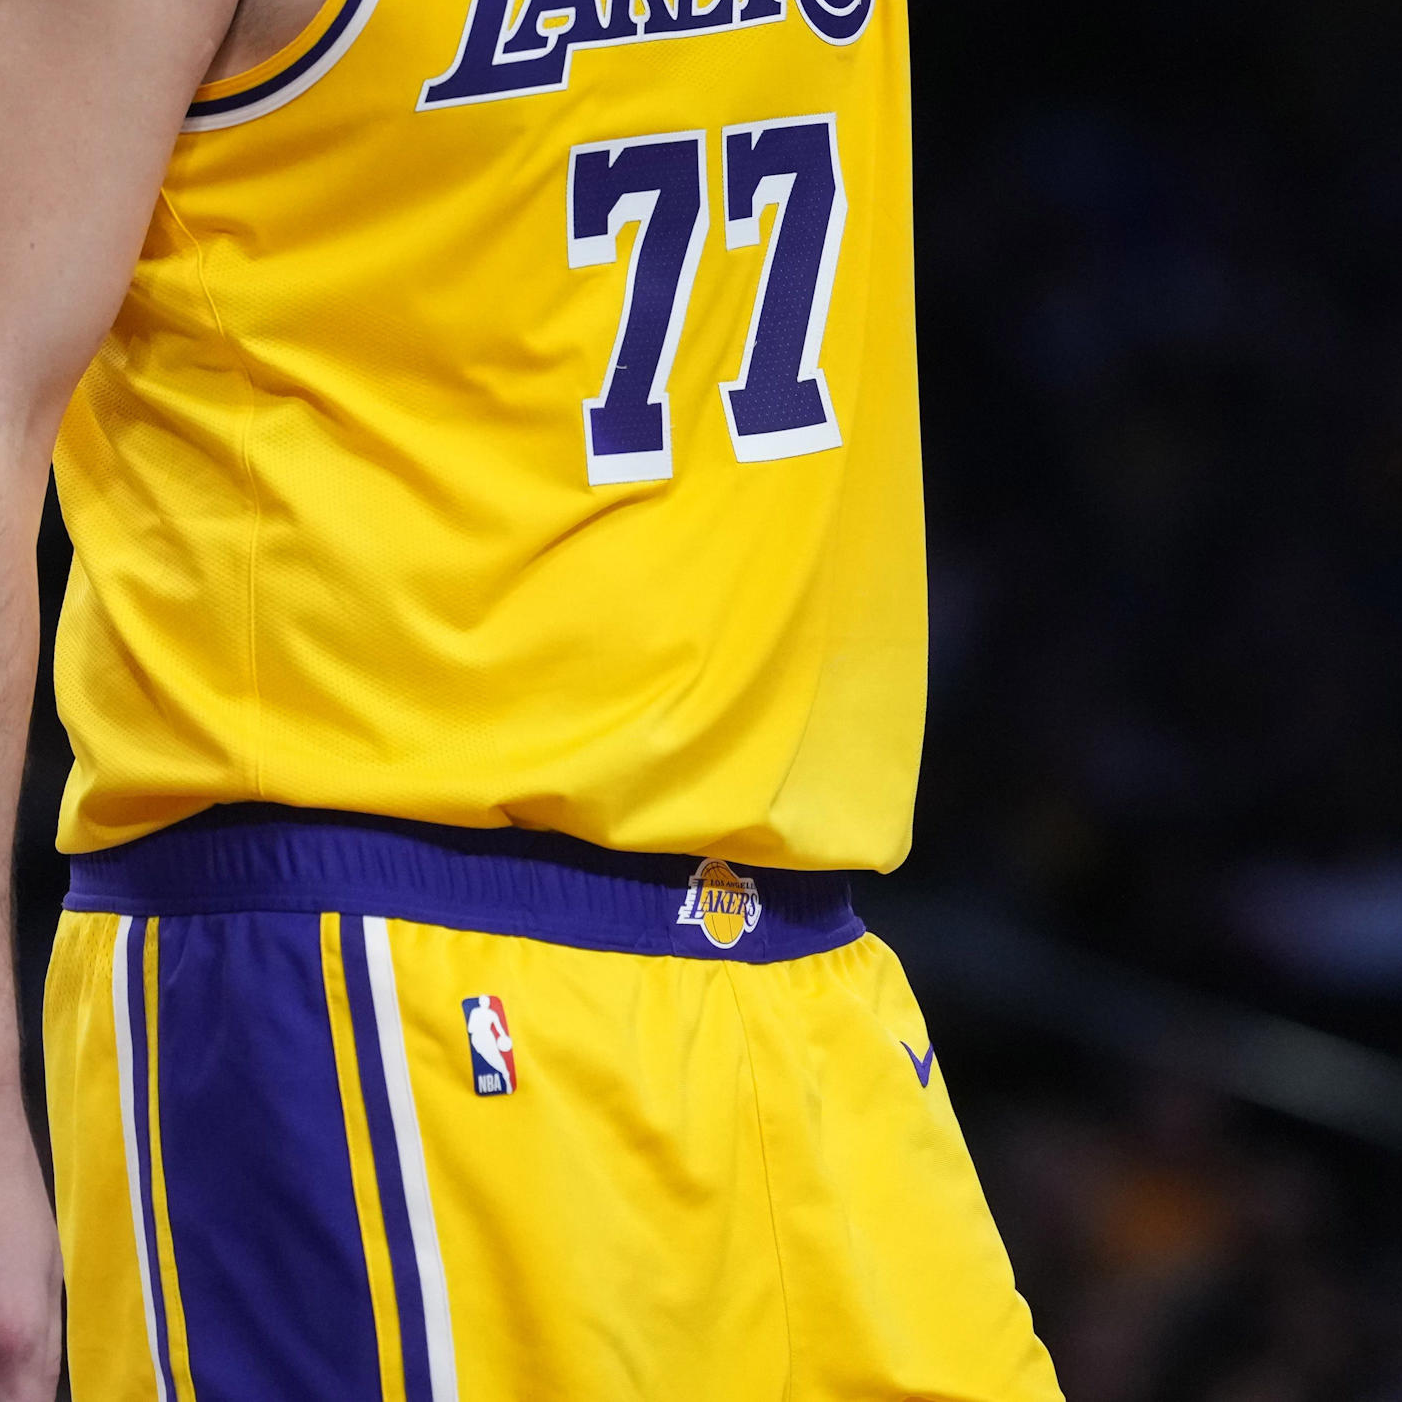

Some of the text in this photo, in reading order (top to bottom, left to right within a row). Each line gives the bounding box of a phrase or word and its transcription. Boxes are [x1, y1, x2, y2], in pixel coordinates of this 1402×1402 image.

[566, 112, 848, 486] 77
[710, 879, 756, 889] LOS ANGELE
[682, 878, 758, 927] LAKERS
[478, 1073, 502, 1093] NBA
